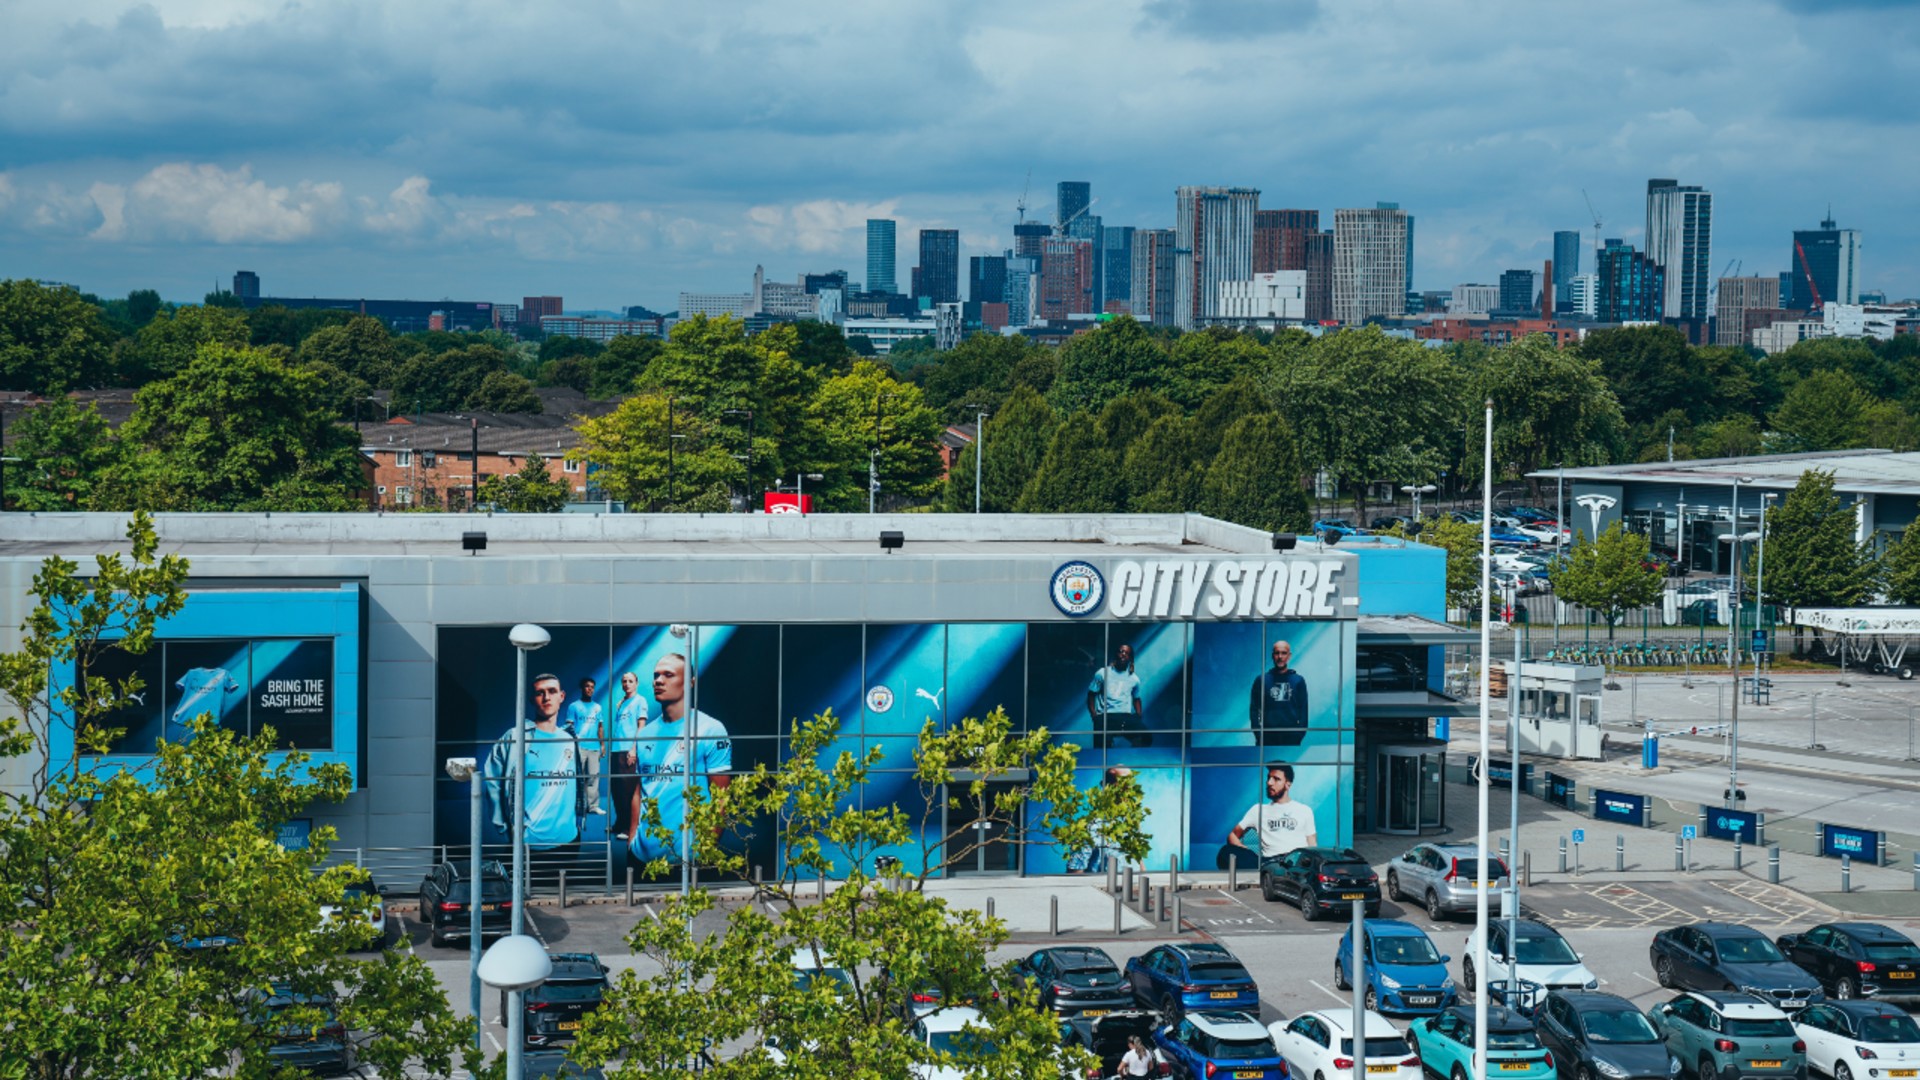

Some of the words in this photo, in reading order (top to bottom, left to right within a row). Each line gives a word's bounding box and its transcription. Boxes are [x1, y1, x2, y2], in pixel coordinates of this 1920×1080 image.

[1109, 561, 1211, 617] CITY
[1208, 561, 1344, 617] STORE
[268, 680, 302, 693] BRING
[303, 679, 325, 693] THE
[261, 694, 291, 708] SASH
[293, 694, 325, 707] HOME
